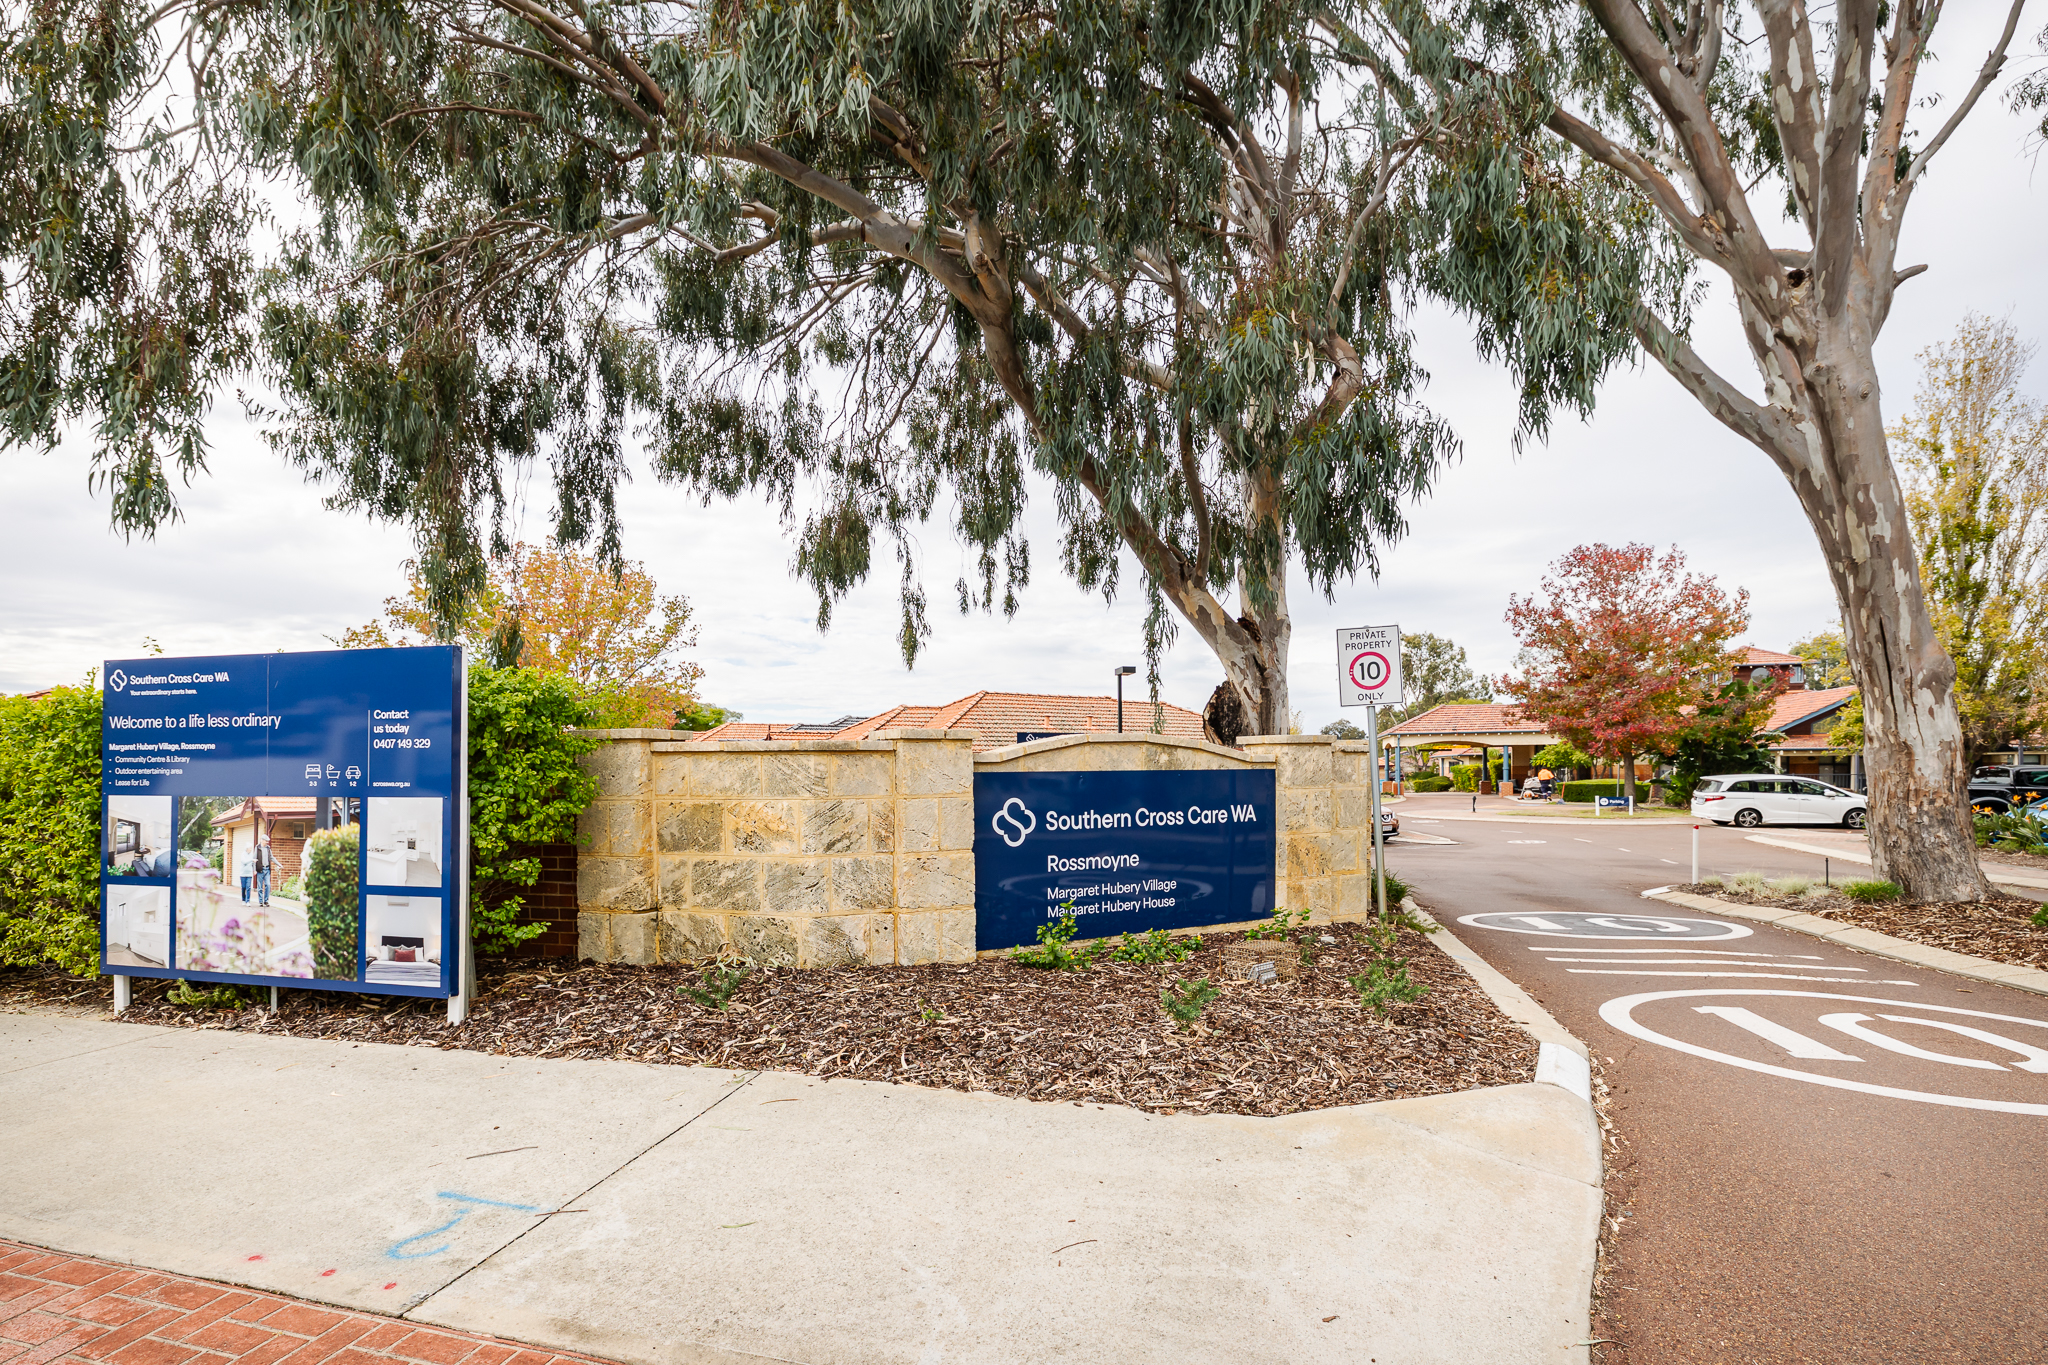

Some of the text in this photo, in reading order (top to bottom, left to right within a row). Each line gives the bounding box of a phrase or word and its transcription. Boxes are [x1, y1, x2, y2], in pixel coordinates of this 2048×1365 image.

[1350, 630, 1386, 640] PRIVATE
[1345, 640, 1392, 650] PROPERTY
[1359, 661, 1380, 680] 10
[130, 672, 230, 685] Southern Cross Care WA
[1358, 692, 1384, 701] ONLY
[373, 709, 409, 719] Contact
[109, 713, 281, 730] Welcome to a life less ordinary
[373, 723, 410, 735] us today
[108, 742, 216, 752] Margaret Hubery Village, Rossmoyne
[373, 738, 431, 749] 0407 149 329
[115, 756, 146, 764] Community
[171, 756, 190, 764] Library
[138, 767, 170, 776] entertaining
[1045, 804, 1257, 831] Southern Cross Care WA
[1047, 854, 1140, 872] Rossmoyne
[1047, 879, 1177, 900] Margaret Hubery Village
[1102, 900, 1141, 913] Hubery
[1143, 897, 1175, 909] House
[1509, 915, 1692, 932] 10
[1691, 1004, 2048, 1074] 10
